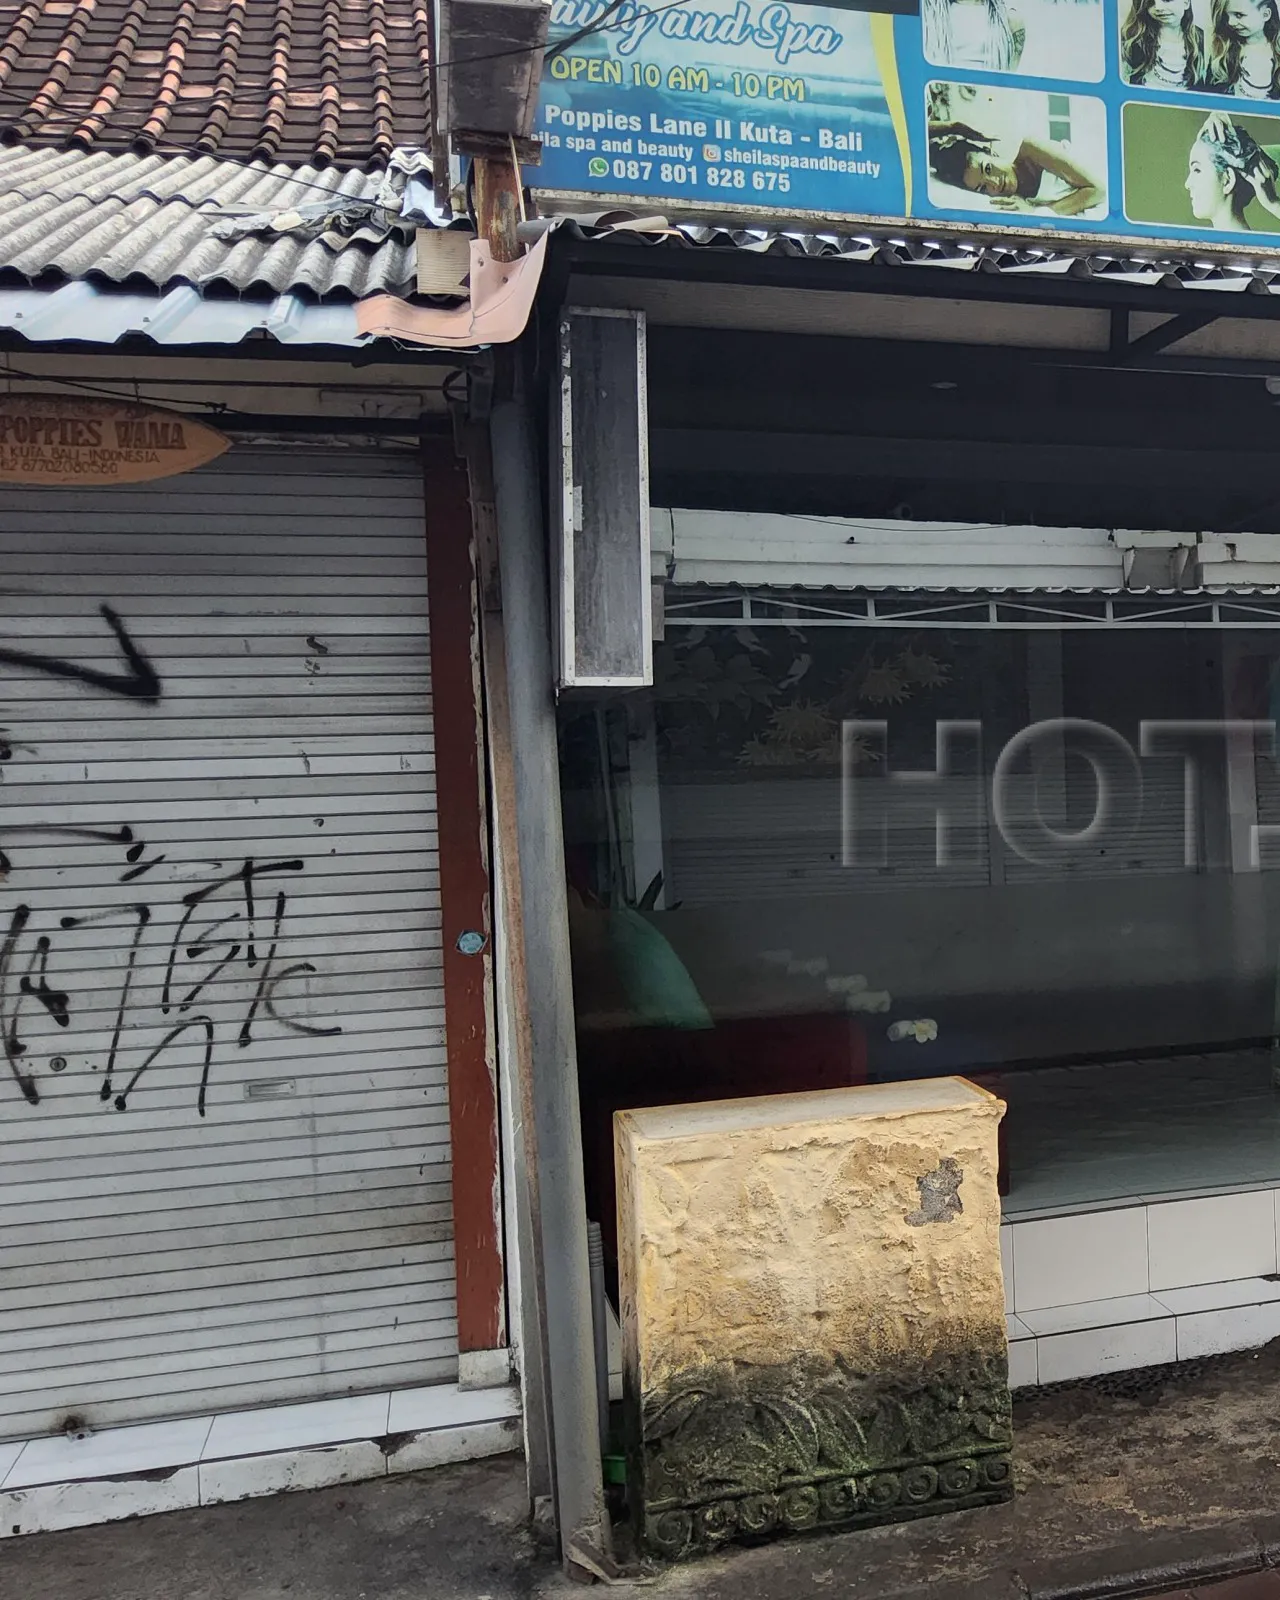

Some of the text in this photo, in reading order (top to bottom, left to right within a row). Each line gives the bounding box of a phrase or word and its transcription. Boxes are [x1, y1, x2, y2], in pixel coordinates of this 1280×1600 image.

[661, 1, 753, 46] and
[752, 3, 842, 64] Spa
[551, 56, 622, 84] OPEN
[632, 62, 660, 88] 10
[667, 67, 709, 93] AM
[732, 72, 760, 98] 10
[767, 76, 805, 101] PM
[545, 104, 641, 133] Poppies
[649, 113, 707, 138] Lane
[740, 121, 792, 146] Kuta
[819, 129, 863, 152] Bali
[566, 136, 596, 152] spa
[602, 138, 632, 154] and
[638, 140, 693, 161] beauty
[725, 147, 880, 178] sheilaspaandbeauty
[613, 159, 790, 192] 087 801 828 675
[0, 415, 102, 447] POPPIES
